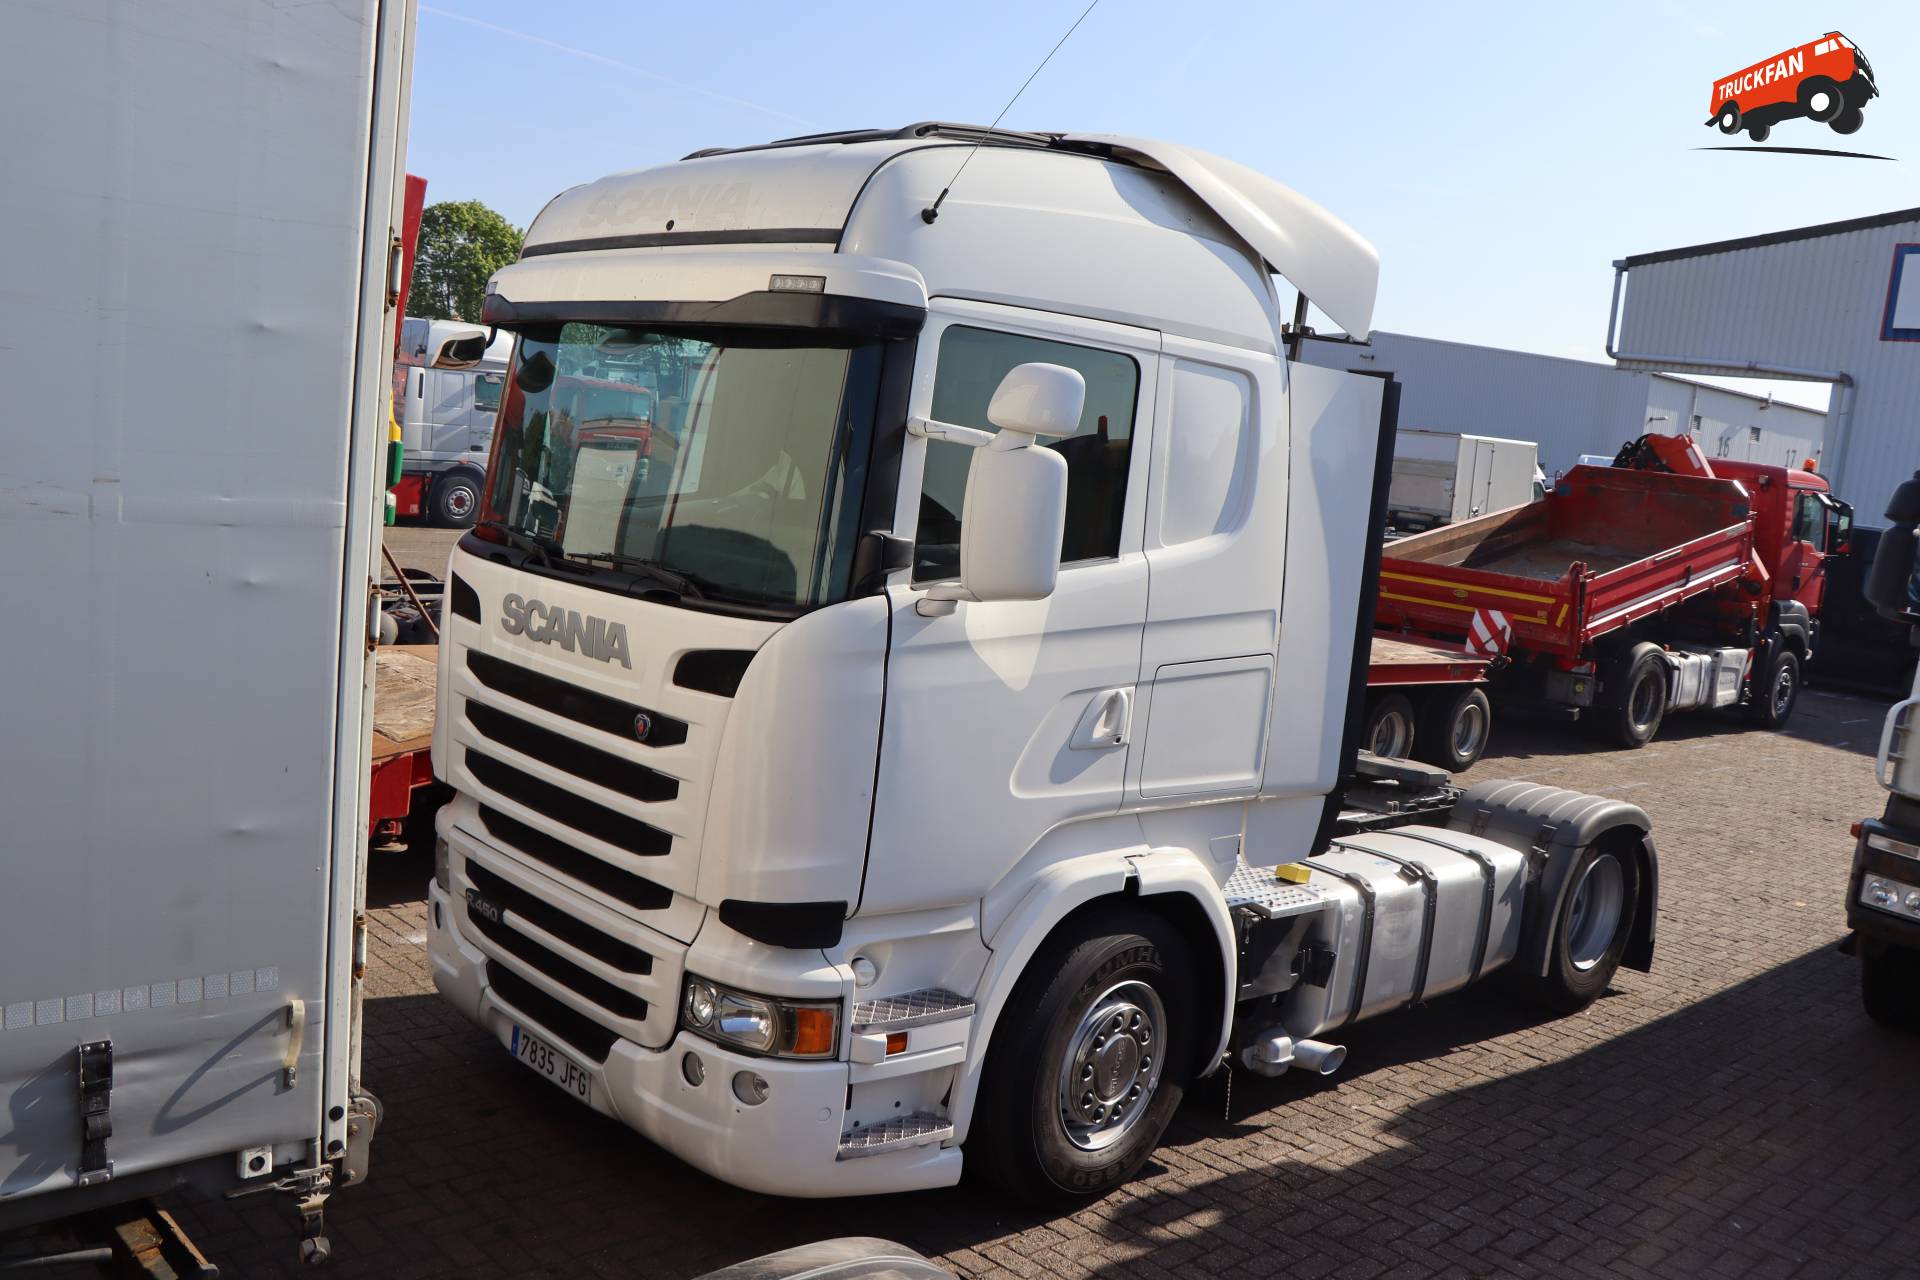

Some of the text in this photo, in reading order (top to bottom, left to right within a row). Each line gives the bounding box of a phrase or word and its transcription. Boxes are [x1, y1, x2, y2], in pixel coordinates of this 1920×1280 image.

[1717, 436, 1731, 457] 16
[501, 593, 632, 669] SCANIA
[520, 1033, 587, 1096] 7835 JFG
